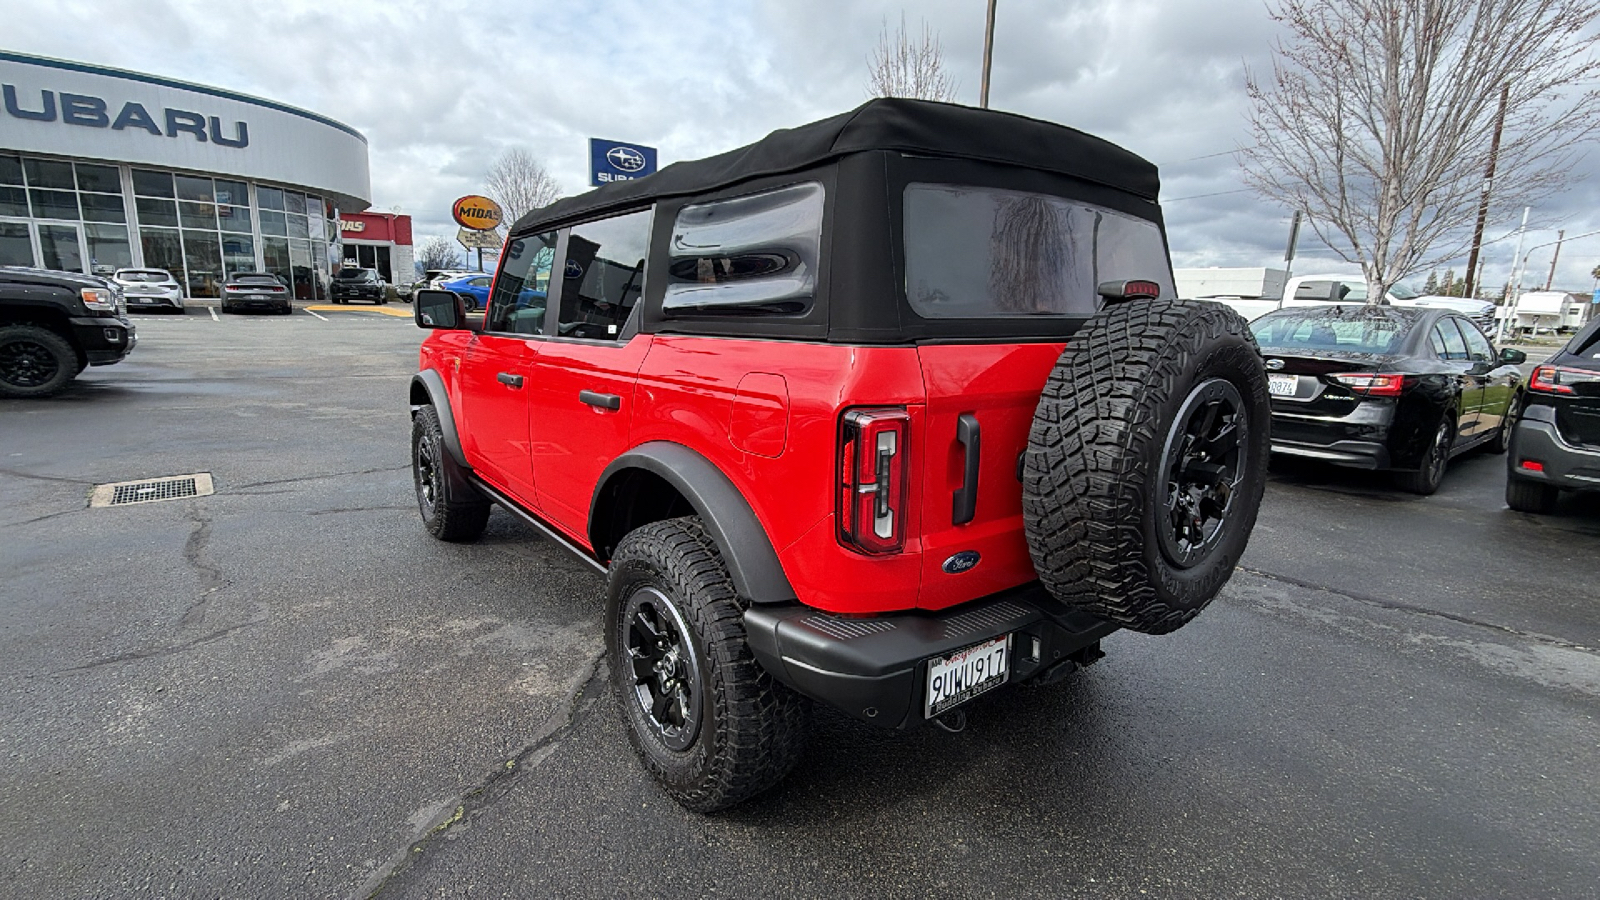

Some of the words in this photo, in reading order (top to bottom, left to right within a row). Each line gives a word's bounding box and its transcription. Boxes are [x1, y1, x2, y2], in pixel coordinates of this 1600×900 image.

[1, 83, 249, 149] UBARU
[459, 206, 499, 221] MIDAS
[952, 557, 974, 571] Ford
[932, 647, 1004, 705] 9UWU917
